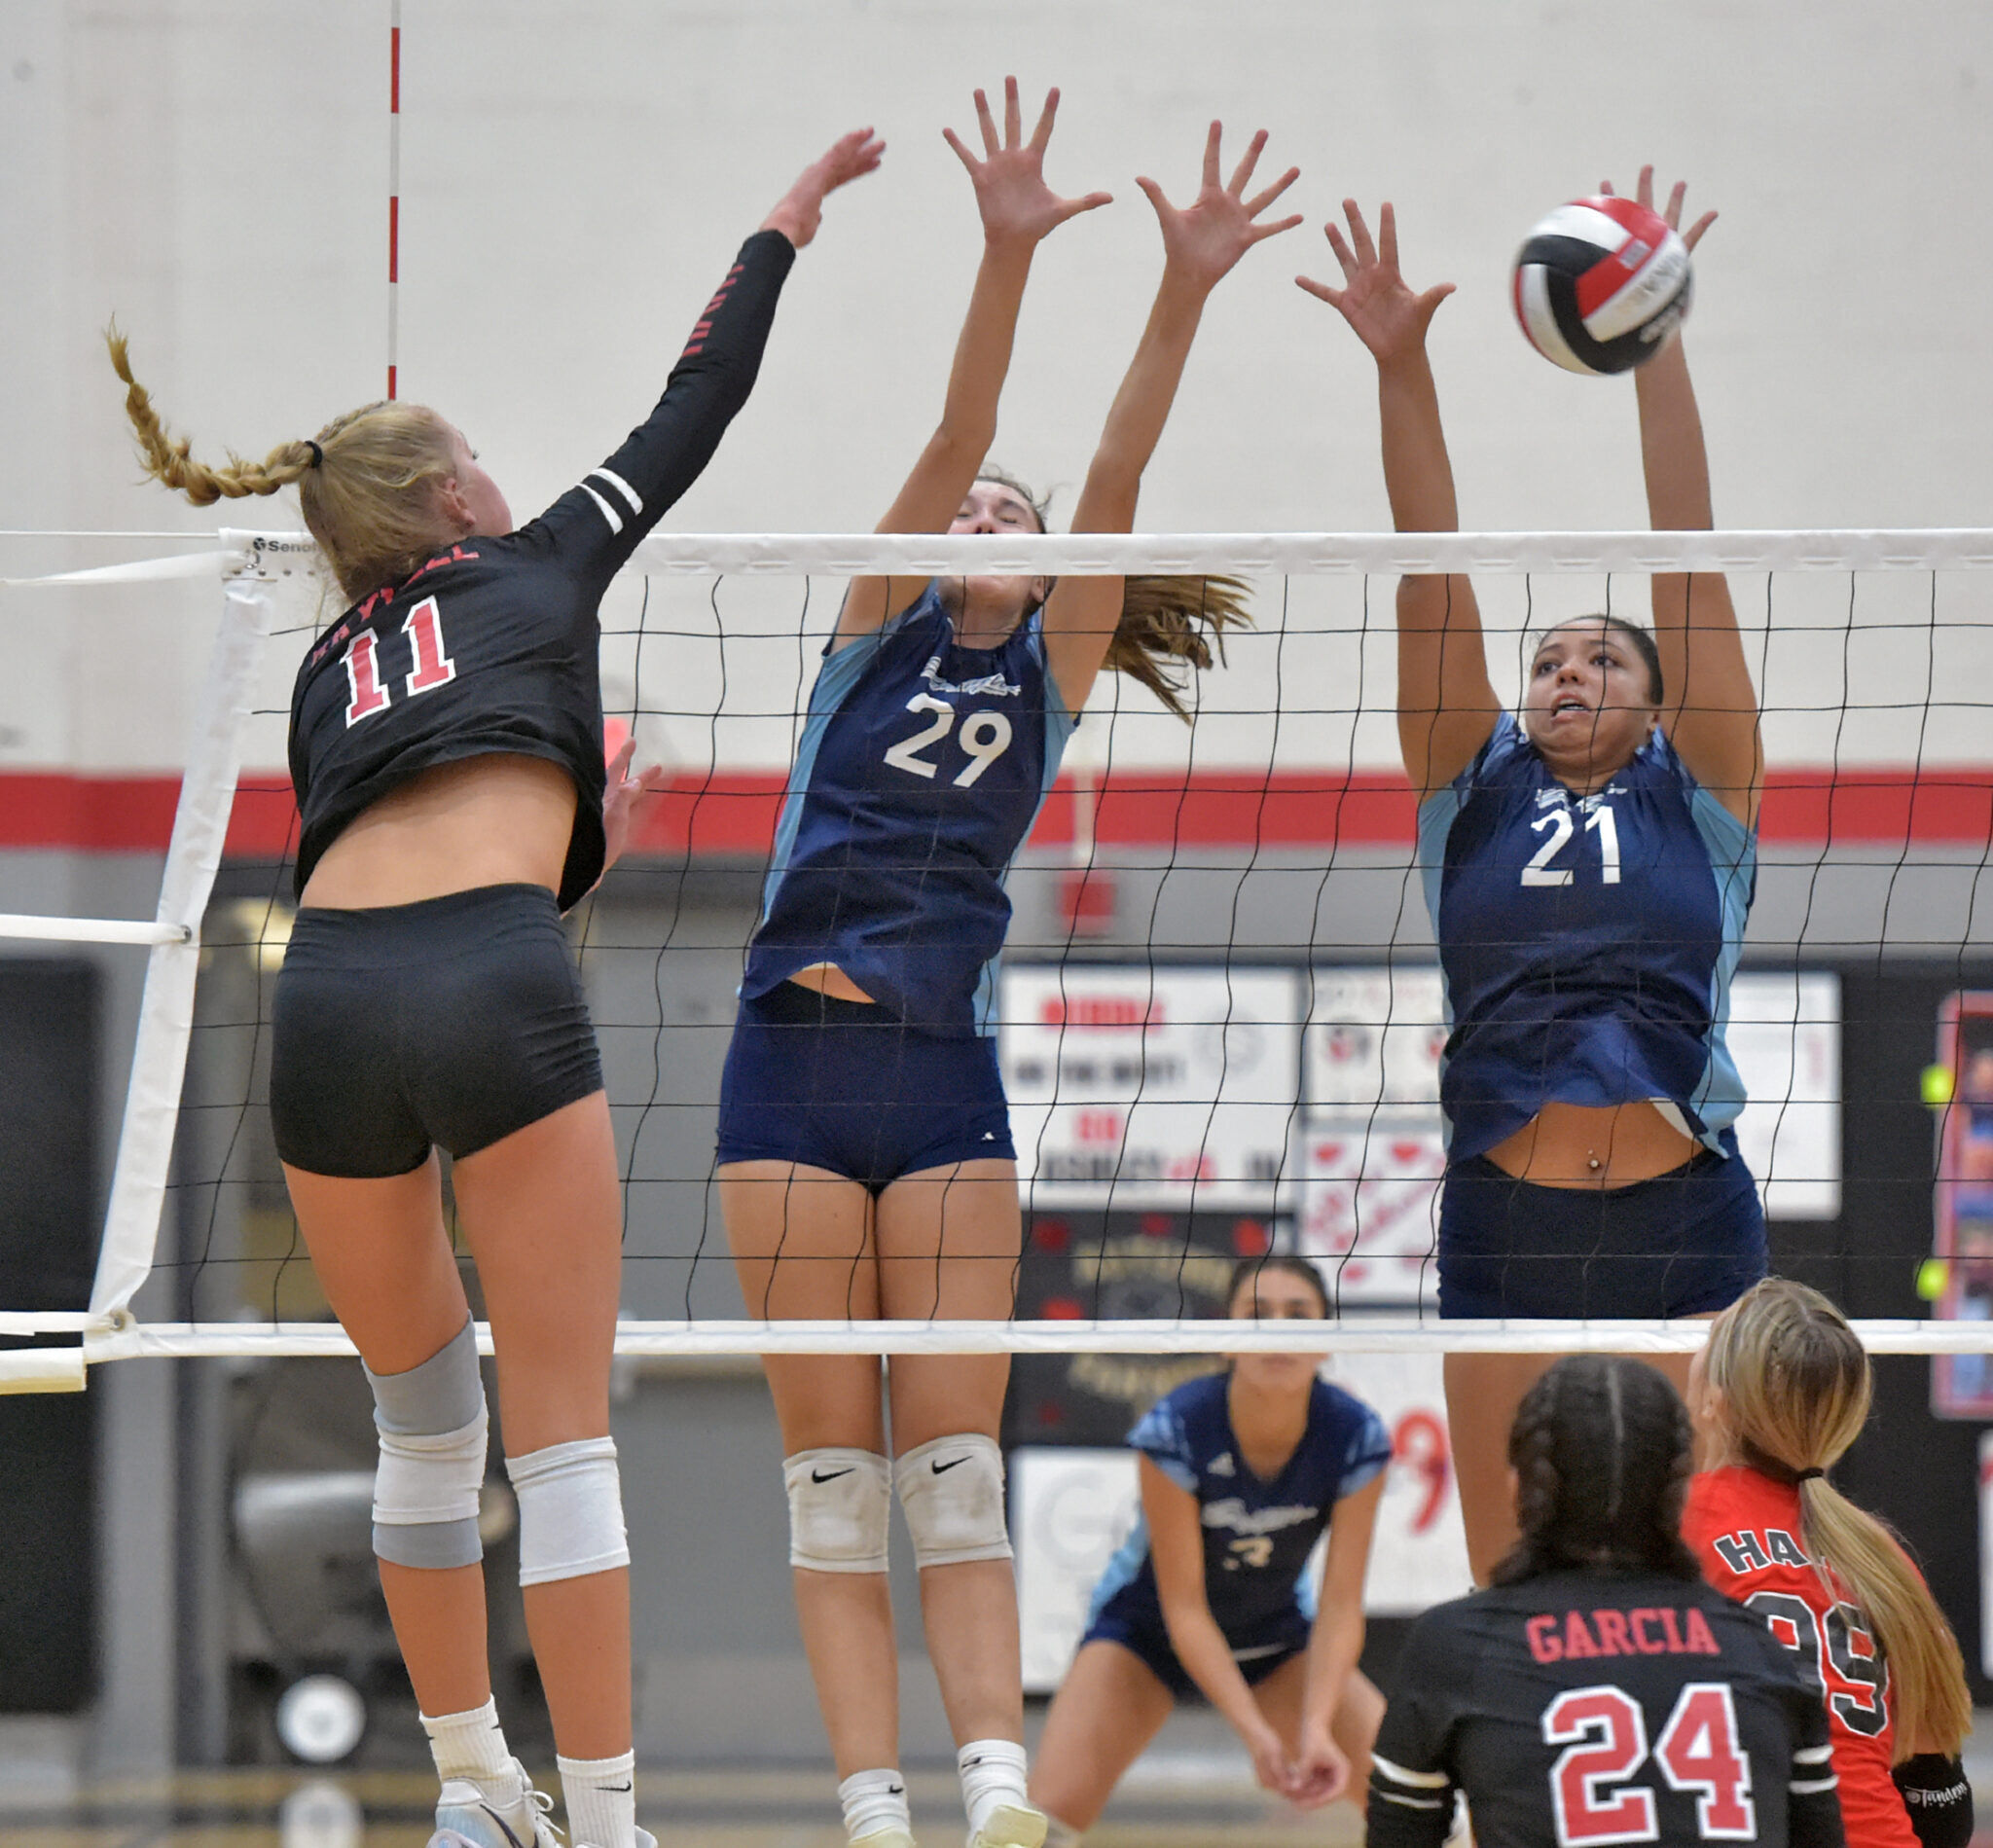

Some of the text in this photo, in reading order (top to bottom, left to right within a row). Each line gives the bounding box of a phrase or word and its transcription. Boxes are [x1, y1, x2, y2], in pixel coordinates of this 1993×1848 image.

[339, 595, 456, 729] 11
[884, 693, 1012, 788] 29
[1520, 806, 1621, 887] 21
[1526, 1607, 1721, 1665] GARCIA
[1541, 1682, 1757, 1848] 24
